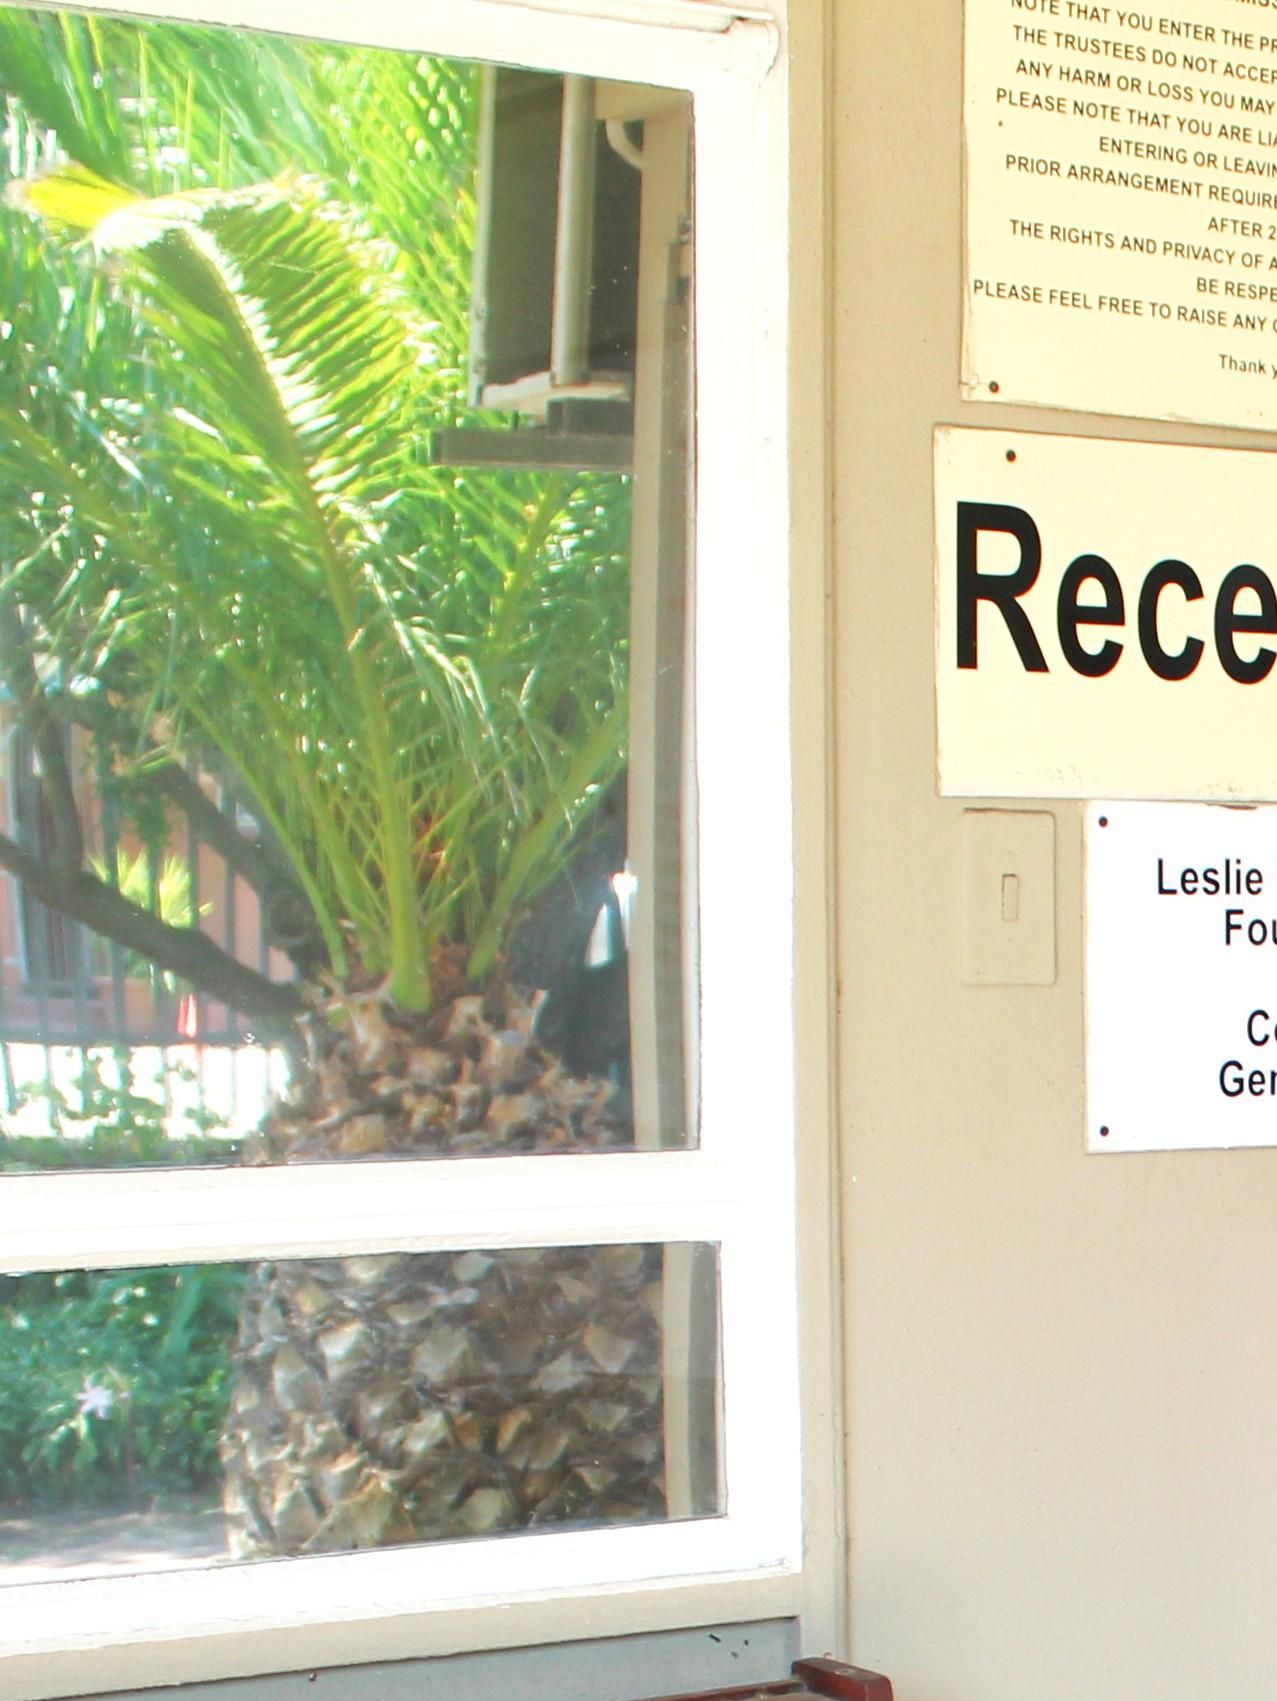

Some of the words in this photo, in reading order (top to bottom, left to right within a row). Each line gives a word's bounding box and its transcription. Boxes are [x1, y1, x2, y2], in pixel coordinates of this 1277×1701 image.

[1066, 1, 1111, 24] THAT
[1116, 10, 1153, 31] YOU
[1159, 18, 1215, 42] ENTER
[1222, 29, 1254, 50] THE
[1013, 24, 1047, 46] THE
[1054, 31, 1146, 62] TRUSTEES
[1152, 49, 1177, 67] DO
[1183, 54, 1218, 74] NOT
[1016, 59, 1053, 79] ANY
[1059, 65, 1111, 88] HARM
[1117, 75, 1142, 94] OR
[1148, 80, 1193, 102] LOSS
[1199, 89, 1235, 109] YOU
[1240, 96, 1275, 115] MAY
[996, 87, 1066, 114] PLEASE
[1073, 100, 1120, 122] NOTE
[1127, 108, 1171, 129] THAT
[1176, 116, 1212, 137] YOU
[1217, 124, 1252, 143] ARE
[1099, 136, 1188, 164] ENTERING
[1193, 151, 1218, 169] OR
[1006, 154, 1061, 177] PRIOR
[1067, 164, 1203, 198] ARRANGEMENT
[1010, 219, 1043, 239] THE
[1050, 225, 1115, 249] RIGHTS
[1120, 235, 1157, 254] AND
[1163, 241, 1235, 264] PRIVACY
[1241, 252, 1263, 268] OF
[1208, 217, 1262, 238] AFTER
[974, 279, 1042, 303] PLEASE
[1049, 289, 1092, 310] FEEL
[1098, 295, 1142, 316] FREE
[1149, 302, 1171, 319] TO
[1177, 305, 1227, 327] RAISE
[1233, 313, 1267, 331] ANY
[1197, 277, 1218, 294] BE
[1219, 354, 1266, 374] Thank
[1158, 859, 1262, 895] Leslie
